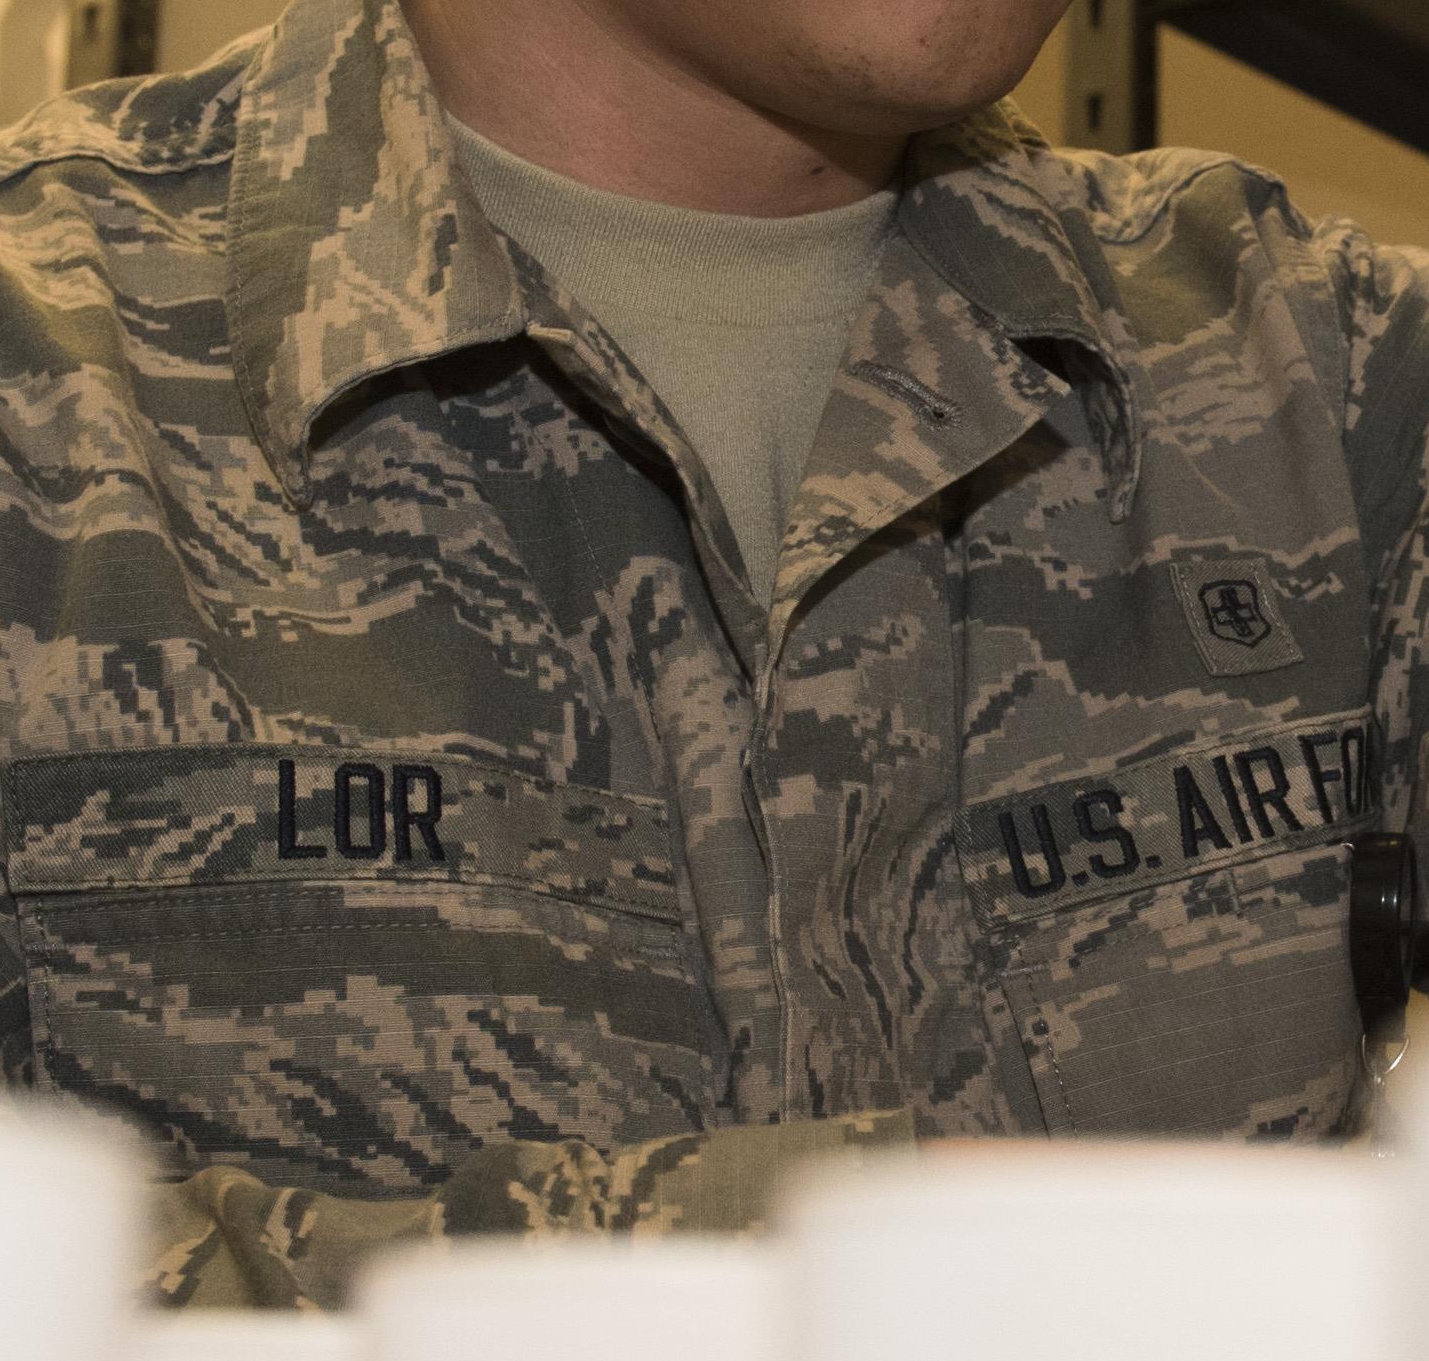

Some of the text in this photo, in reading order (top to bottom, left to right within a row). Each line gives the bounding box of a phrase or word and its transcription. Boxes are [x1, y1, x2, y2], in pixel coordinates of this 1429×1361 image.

[278, 758, 446, 861] LOR
[997, 788, 1163, 899] U.S.
[1172, 745, 1305, 858] AIR
